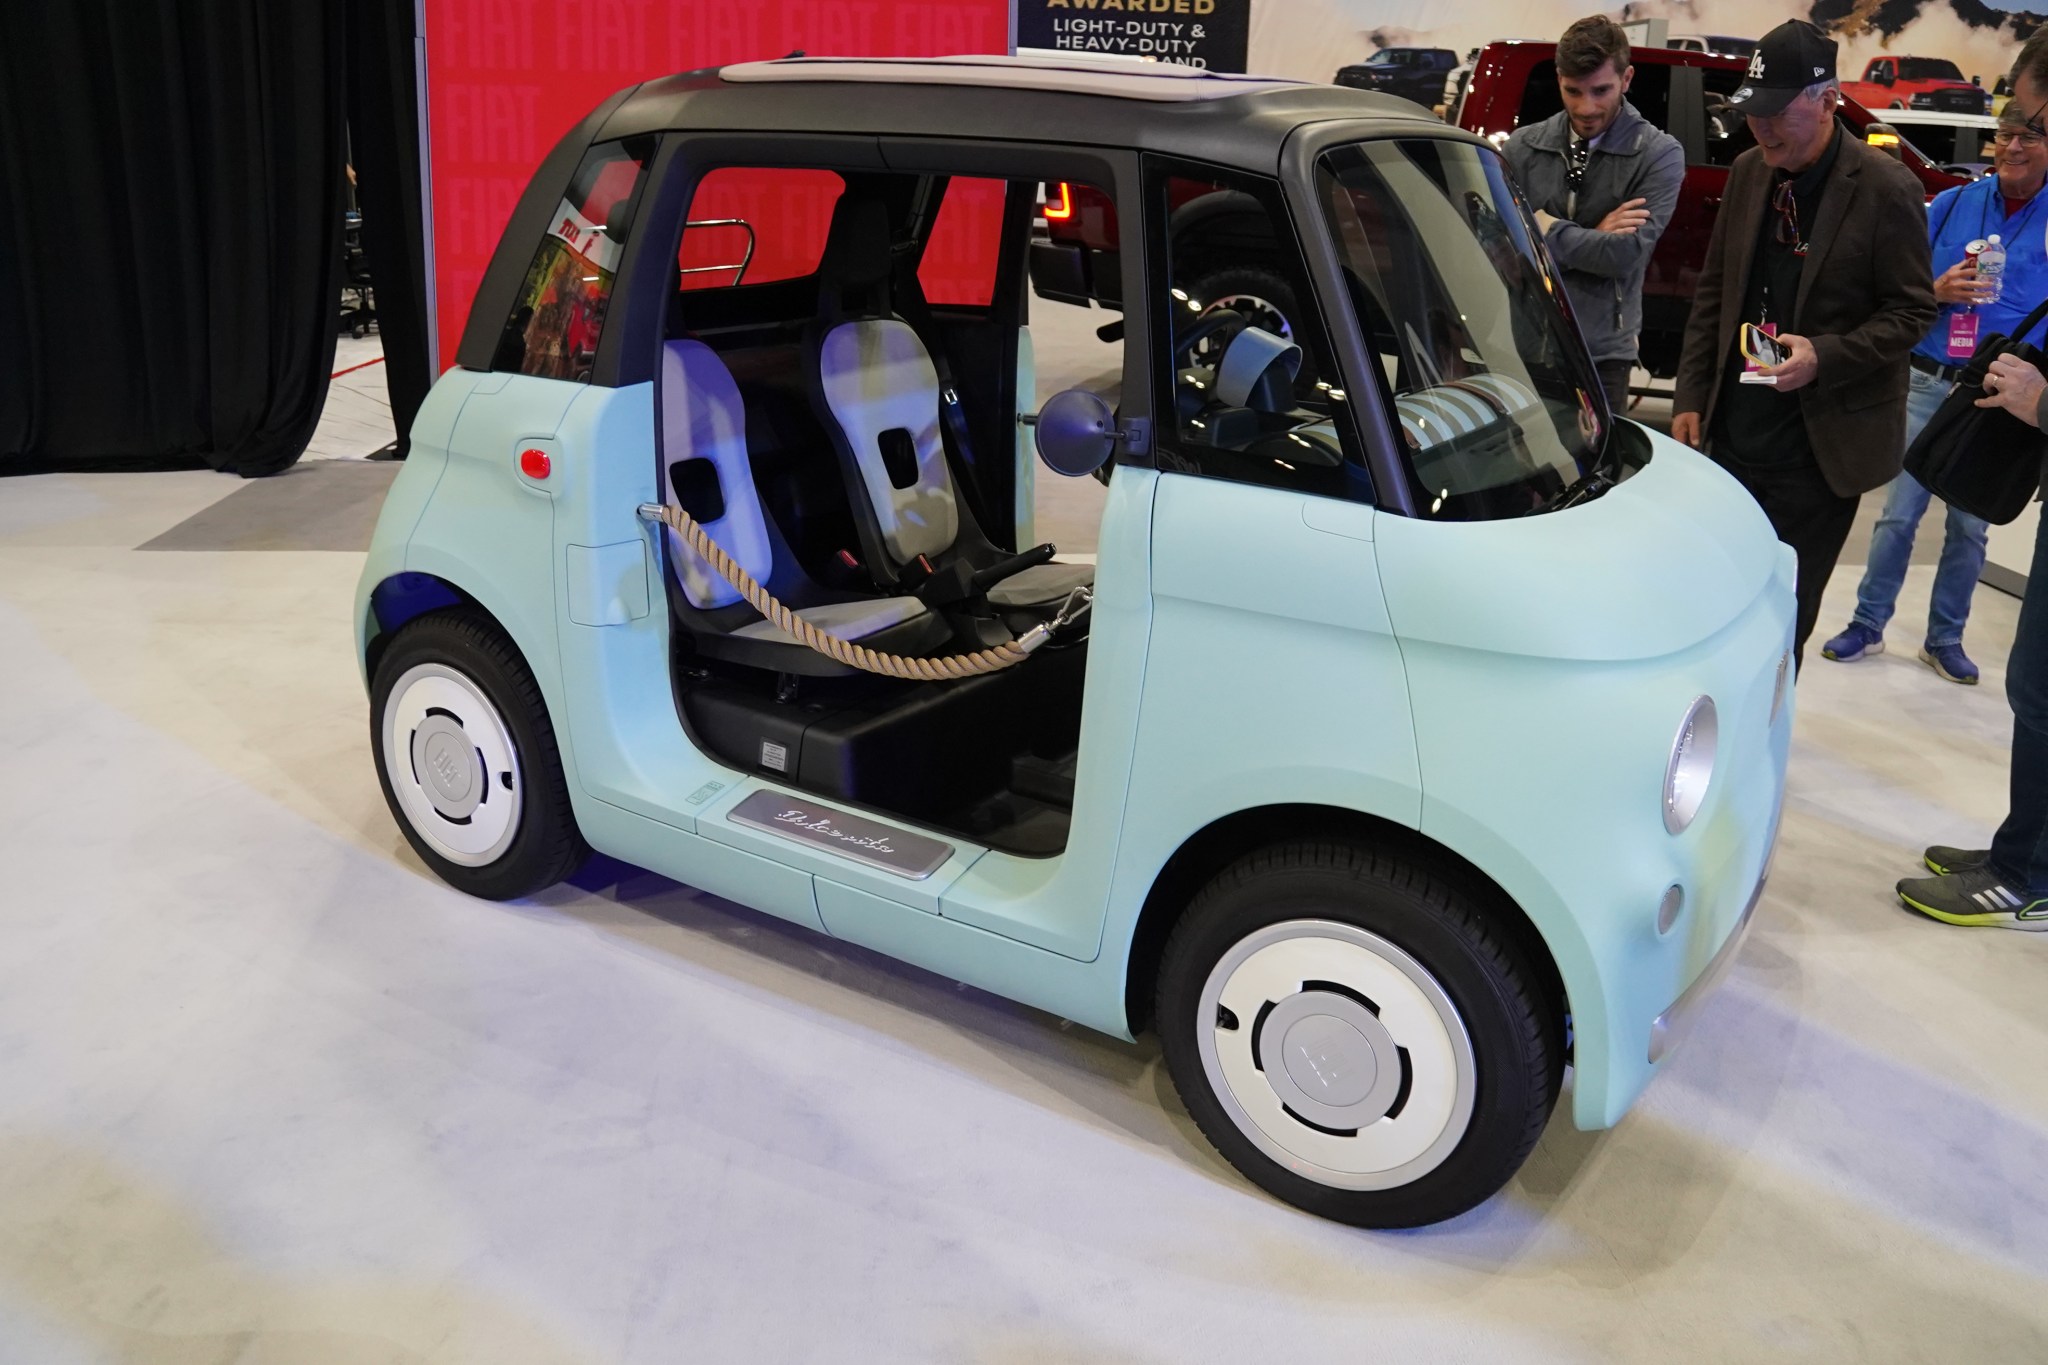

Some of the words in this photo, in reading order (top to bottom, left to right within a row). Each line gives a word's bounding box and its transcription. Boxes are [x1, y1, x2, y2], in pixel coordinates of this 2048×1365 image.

[442, 0, 536, 69] FIAT
[554, 0, 653, 71] FIAT
[669, 0, 767, 69] FIAT
[781, 2, 879, 56] FIAT
[894, 5, 993, 56] FIAT
[1054, 18, 1184, 37] LIGHT-DUTY
[1191, 24, 1206, 38] &
[1056, 35, 1197, 53] HEAVY-DUTY
[1748, 49, 1766, 79] LA
[445, 83, 543, 163] FIAT
[1950, 337, 1974, 347] MEDIA
